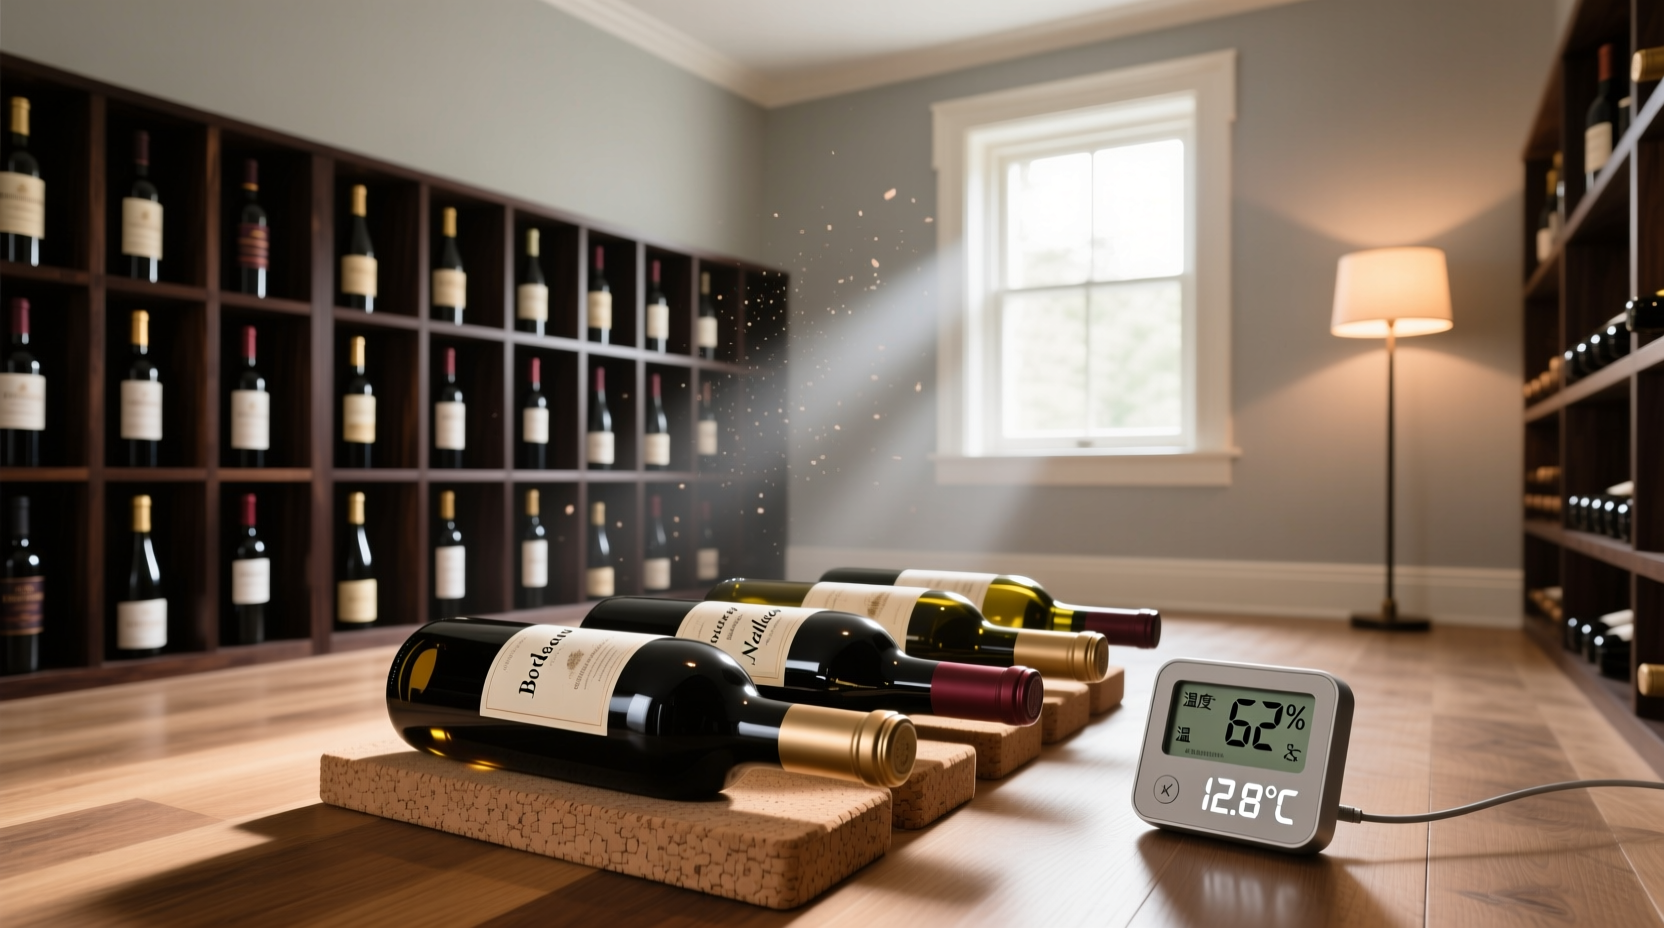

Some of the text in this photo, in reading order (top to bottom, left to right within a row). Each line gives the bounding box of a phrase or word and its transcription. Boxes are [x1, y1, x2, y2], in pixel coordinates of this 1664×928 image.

[1183, 691, 1214, 711] 温度
[1225, 698, 1306, 751] 62%
[1201, 777, 1299, 825] 12.8°C
